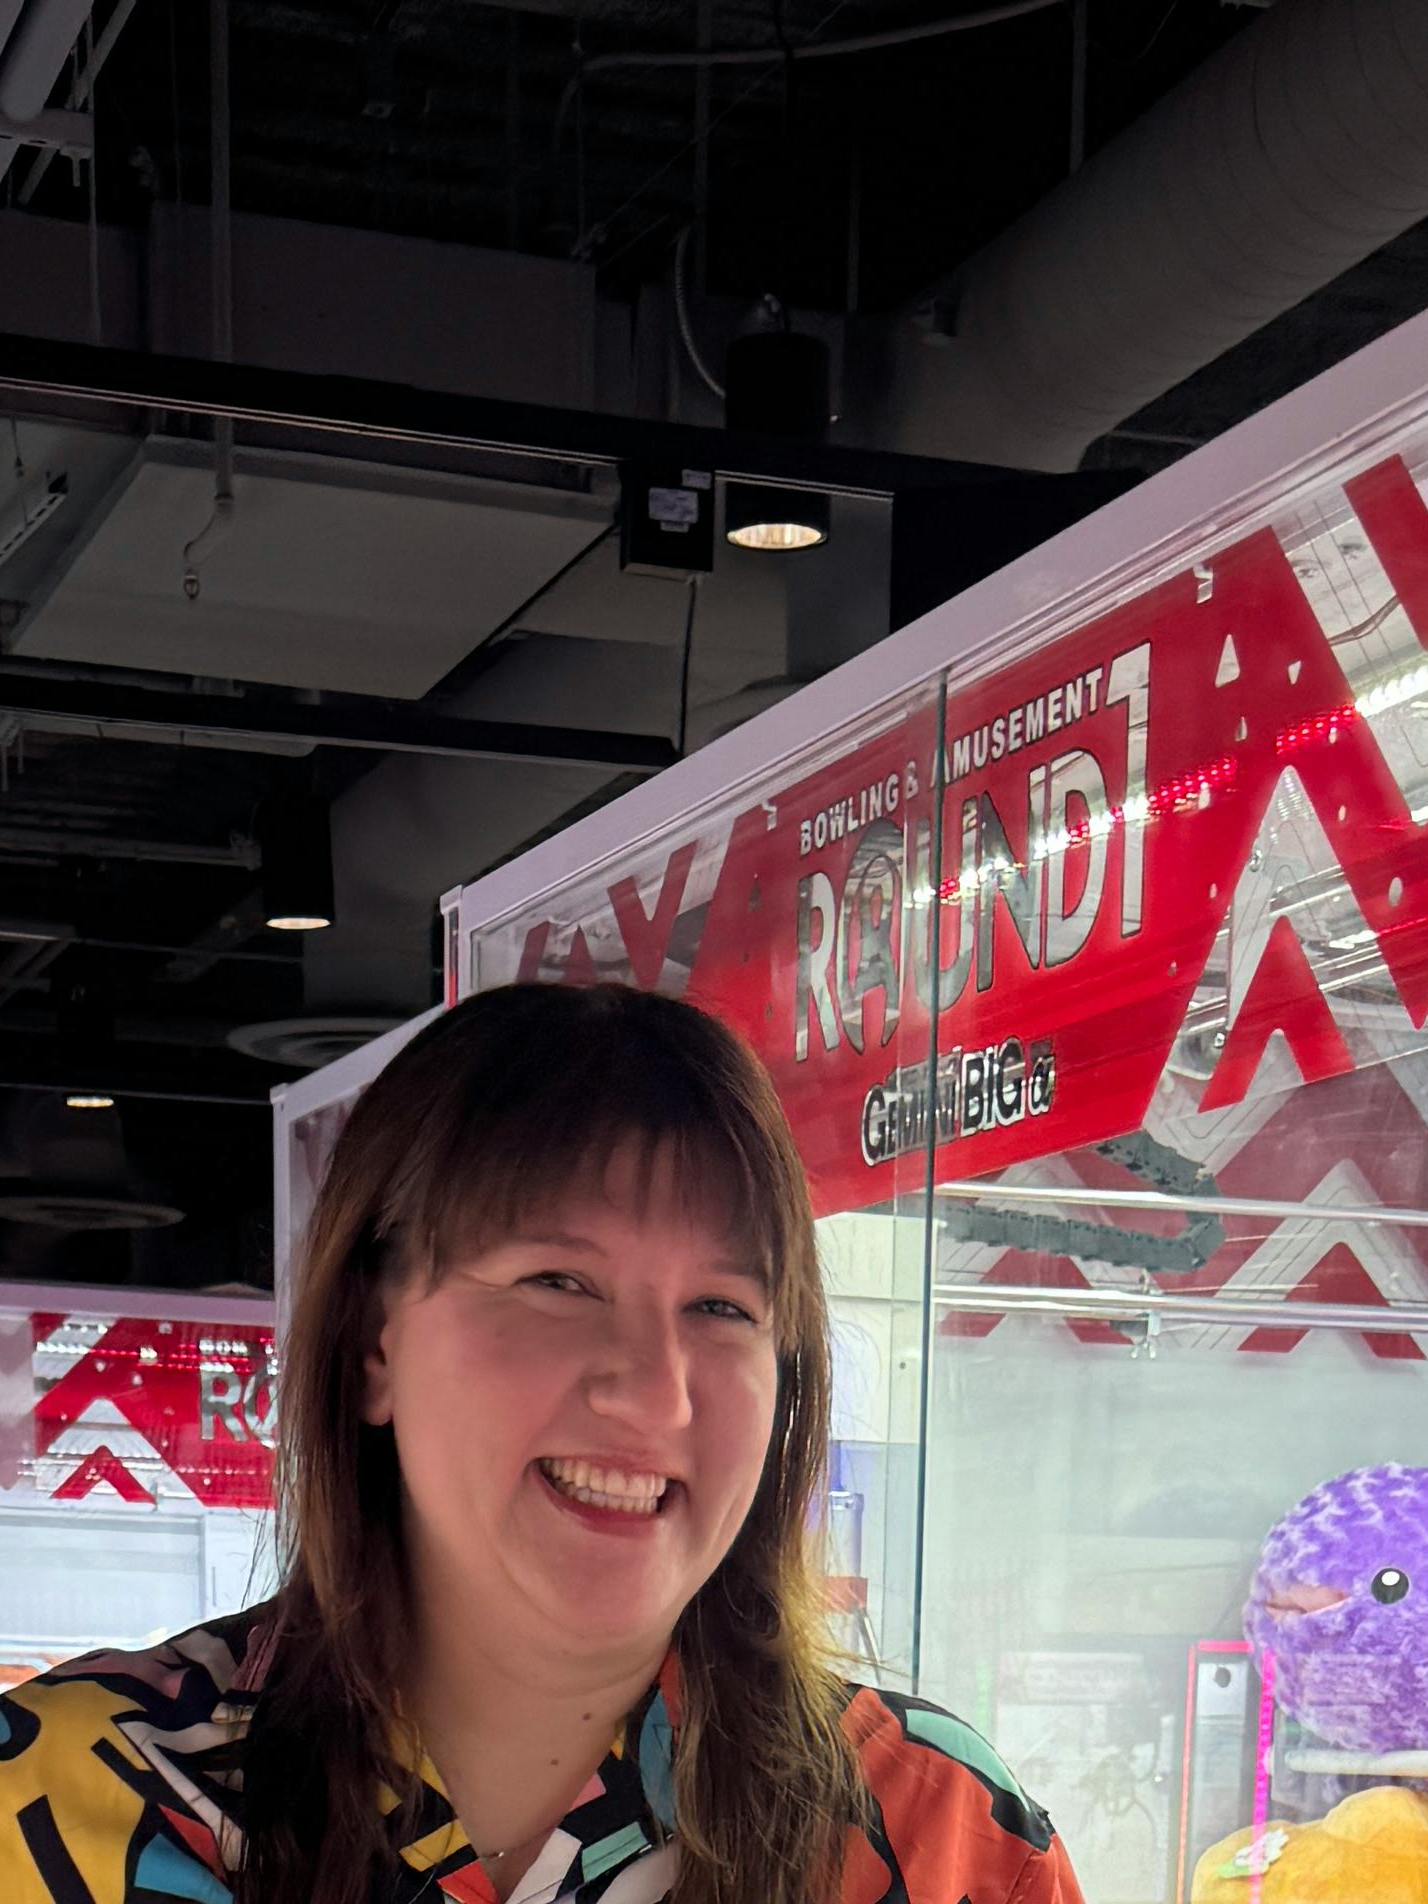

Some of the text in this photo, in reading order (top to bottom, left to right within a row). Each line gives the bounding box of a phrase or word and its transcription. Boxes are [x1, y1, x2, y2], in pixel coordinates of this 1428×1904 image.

[799, 666, 1104, 856] BOWLING & AMUSEMENT
